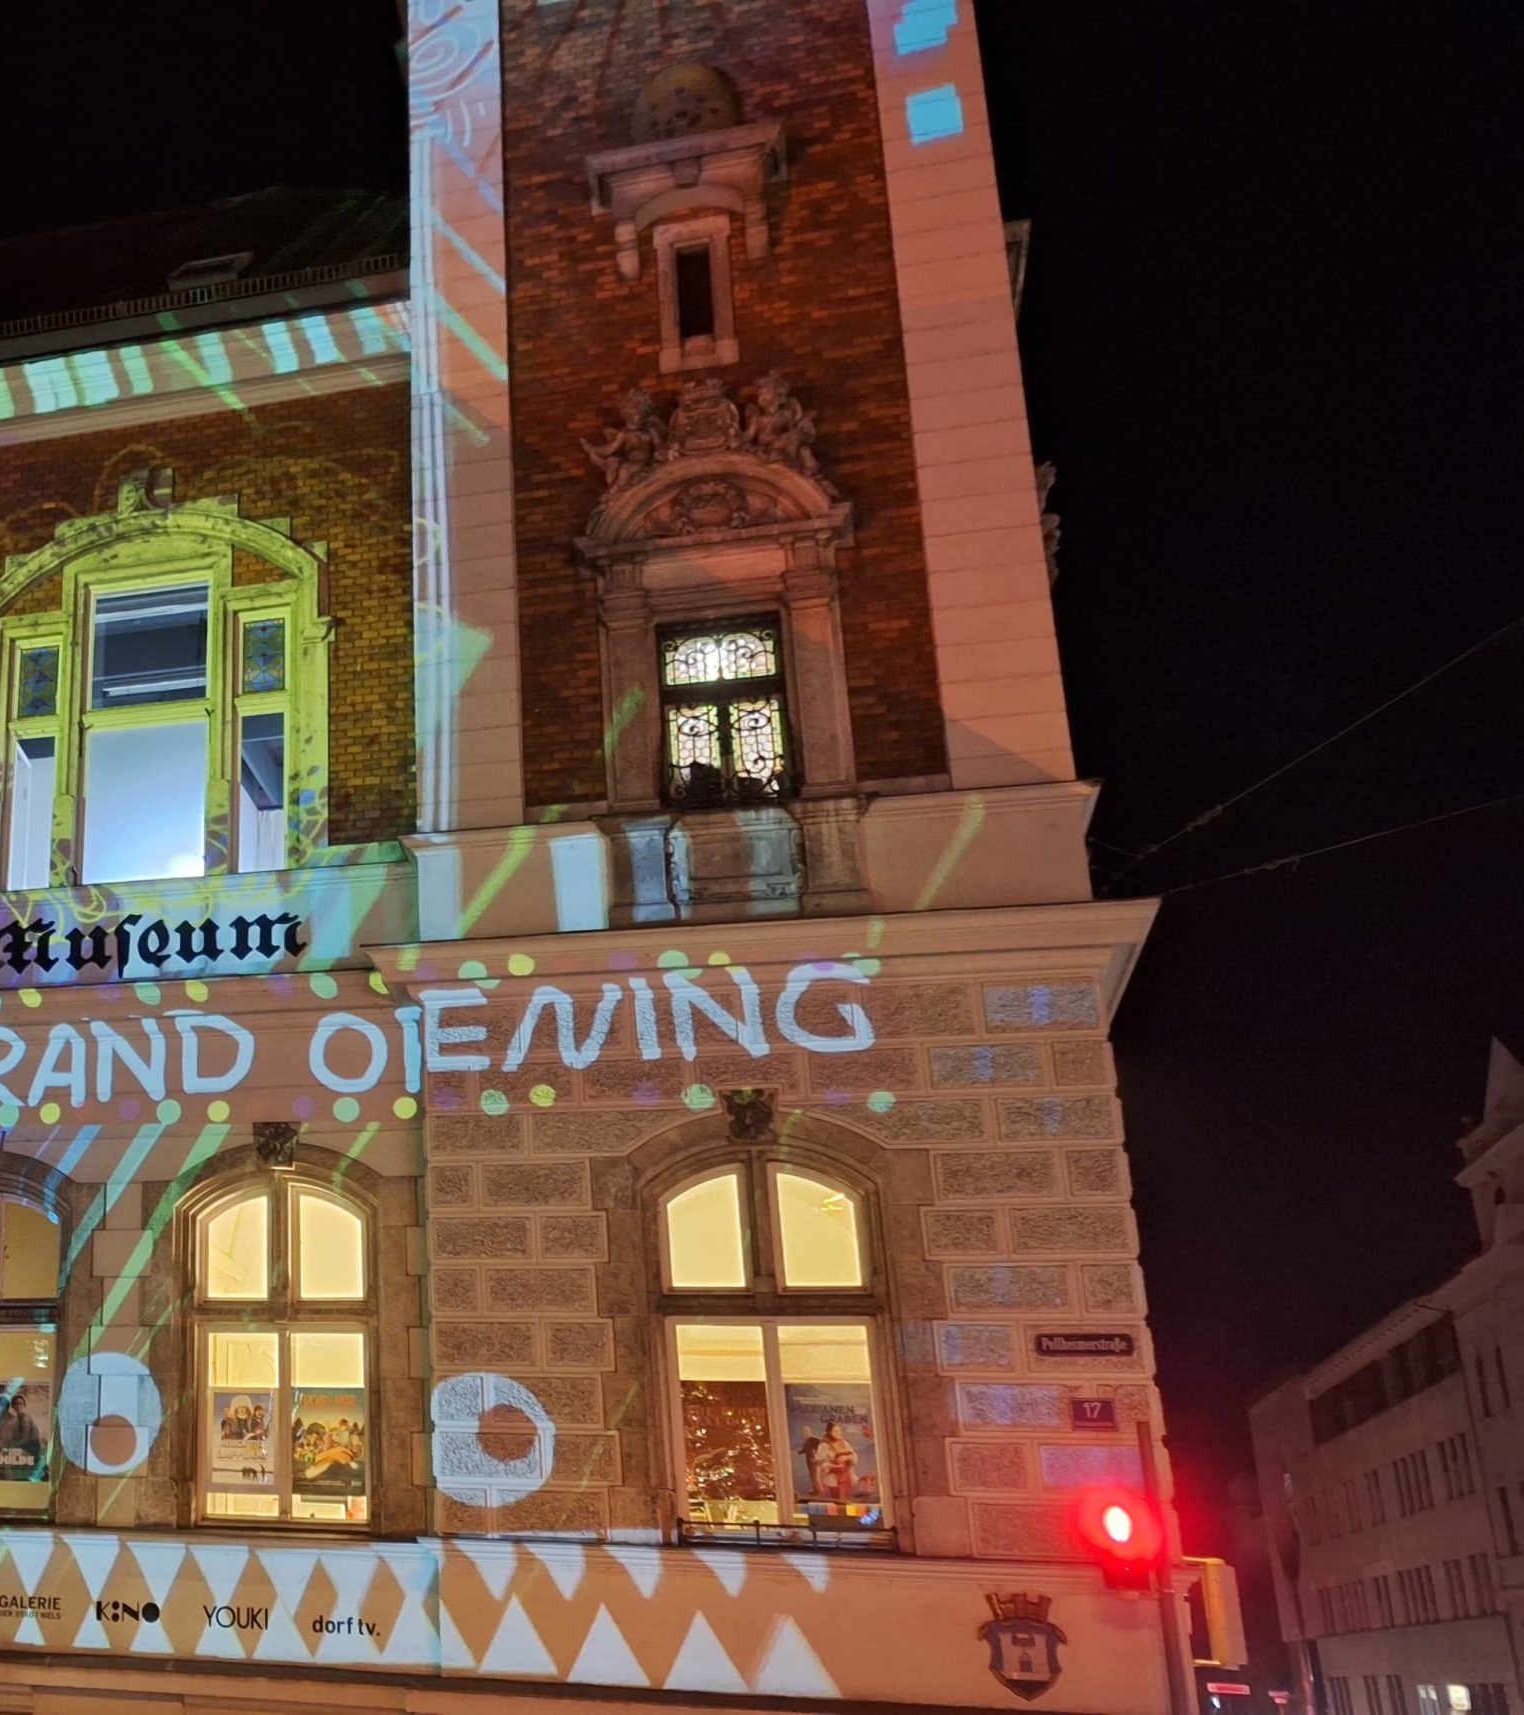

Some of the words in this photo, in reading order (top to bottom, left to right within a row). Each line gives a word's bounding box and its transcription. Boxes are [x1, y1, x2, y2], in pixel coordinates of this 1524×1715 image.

[1082, 1402, 1102, 1420] 17
[41, 1612, 61, 1620] WELS
[203, 1604, 269, 1631] YOUKI
